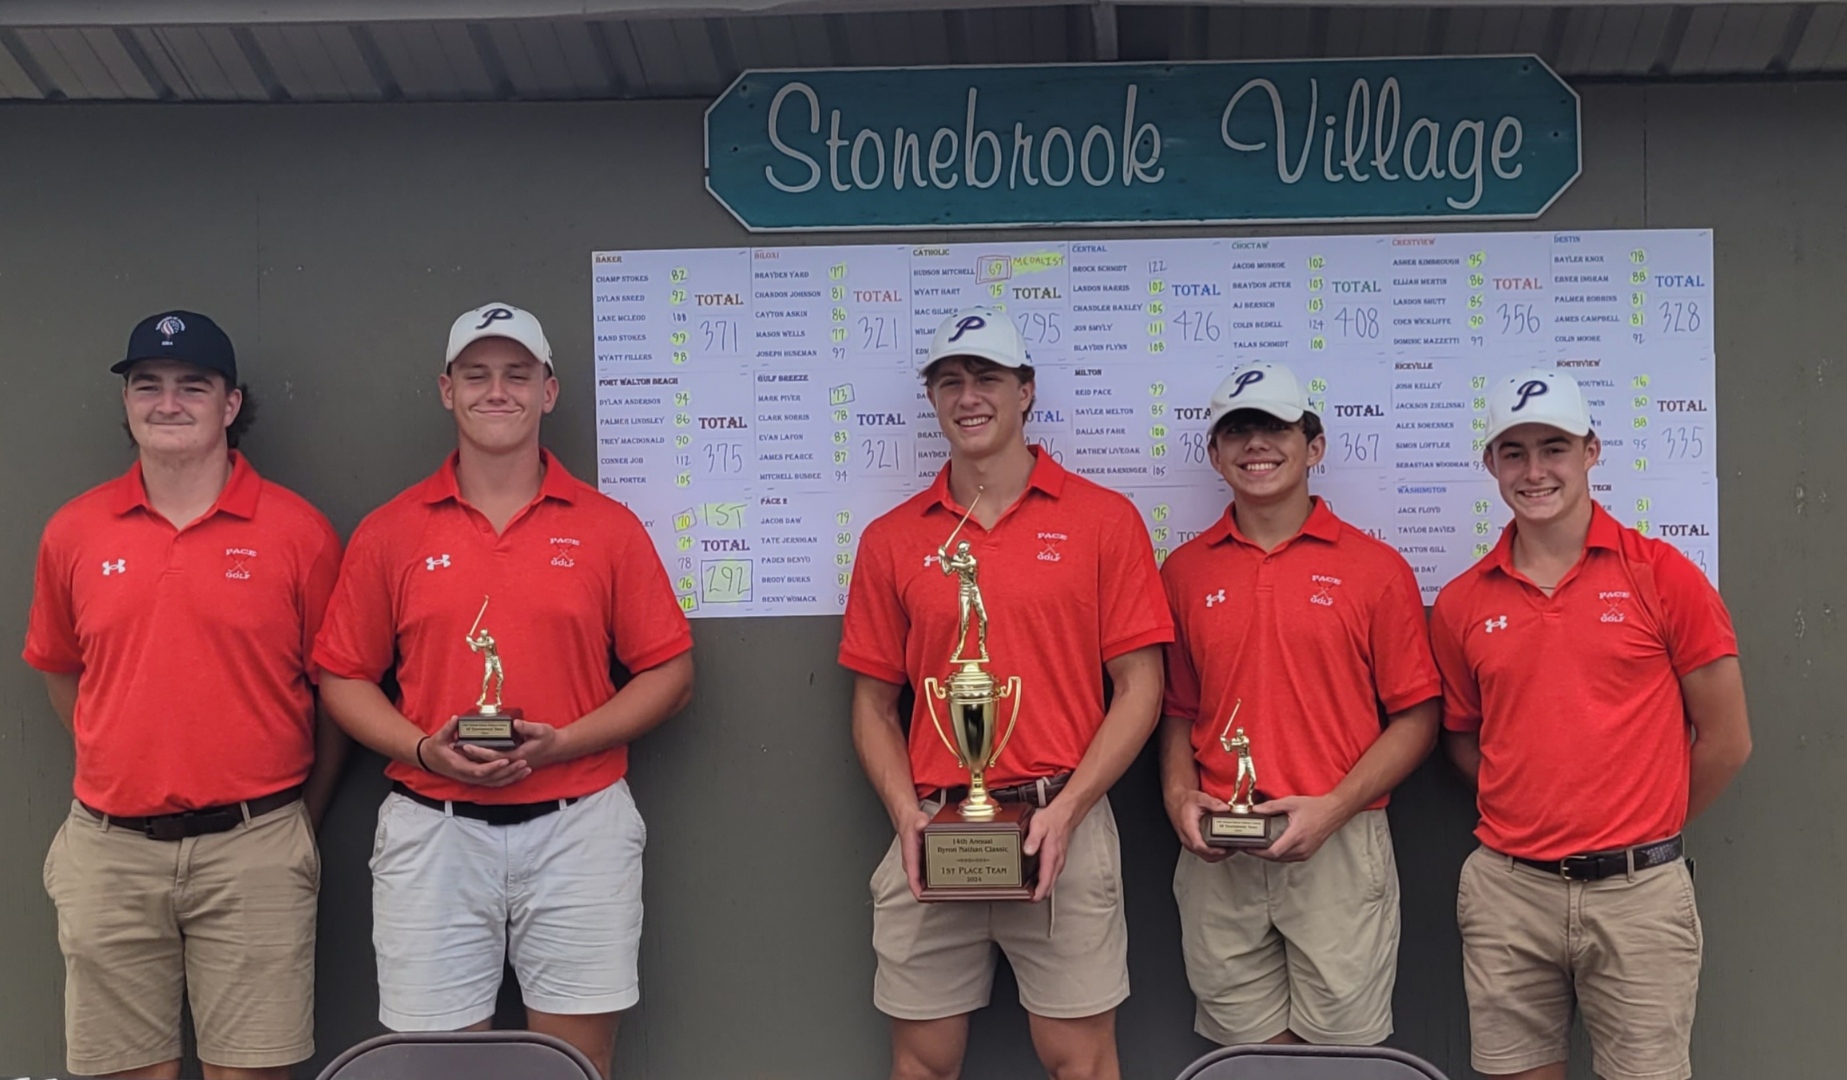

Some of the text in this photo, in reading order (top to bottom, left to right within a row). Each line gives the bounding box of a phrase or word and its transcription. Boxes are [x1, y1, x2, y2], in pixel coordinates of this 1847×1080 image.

[765, 76, 1523, 209] Stonebrook Village
[1554, 235, 1580, 243] DESTIN
[1072, 245, 1107, 253] CENTRAL
[1013, 255, 1065, 266] MEDALIST
[1469, 254, 1482, 265] 95
[1631, 251, 1644, 262] 78
[1149, 261, 1166, 272] 122
[1308, 258, 1324, 268] 102
[671, 270, 687, 280] 82
[789, 270, 809, 278] YARD
[830, 266, 844, 278] 77
[988, 264, 1002, 275] 69
[1470, 275, 1483, 285] 86
[1632, 271, 1646, 282] 88
[1655, 275, 1704, 287] TOTAL
[1149, 282, 1165, 292] 102
[1309, 279, 1323, 290] 103
[1332, 281, 1381, 293] TOTAL
[1493, 278, 1542, 290] TOTAL
[831, 288, 843, 299] 81
[914, 288, 937, 296] WYATT
[990, 285, 1002, 296] 75
[1013, 287, 1061, 299] TOTAL
[1172, 284, 1220, 296] TOTAL
[672, 291, 687, 302] 92
[695, 294, 743, 306] TOTAL
[854, 290, 902, 302] TOTAL
[1470, 296, 1481, 307] 85
[1632, 294, 1644, 305] 81
[1150, 303, 1163, 314] 105
[1308, 300, 1323, 310] 103
[475, 308, 513, 329] P
[832, 309, 846, 320] 86
[1497, 303, 1539, 334] 356
[1632, 314, 1643, 325] 81
[1659, 302, 1700, 333] 328
[1174, 310, 1220, 342] 426
[1309, 320, 1324, 330] 124
[1335, 307, 1379, 338] 408
[1470, 316, 1483, 326] 90
[858, 317, 898, 349] 321
[948, 315, 986, 342] P
[1018, 313, 1060, 343] 295
[1150, 323, 1162, 334] 111
[672, 333, 686, 344] 99
[700, 321, 738, 352] 371
[756, 330, 780, 338] MASON
[832, 329, 845, 340] 77
[1633, 334, 1645, 344] 92
[1310, 339, 1323, 348] 100
[1470, 336, 1483, 346] 97
[674, 352, 687, 362] 98
[832, 347, 846, 359] 97
[1229, 370, 1264, 398] P
[1312, 380, 1326, 391] 86
[1472, 377, 1485, 388] 87
[1633, 377, 1646, 387] 76
[833, 389, 847, 401] 73
[1151, 385, 1164, 396] 99
[1511, 380, 1548, 412] P
[675, 392, 689, 405] 94
[1473, 397, 1486, 408] 88
[1634, 397, 1647, 407] 80
[1152, 405, 1163, 415] 85
[1335, 405, 1383, 417] TOTAL
[1657, 400, 1707, 412] TOTAL
[676, 413, 690, 424] 86
[834, 410, 847, 421] 78
[857, 413, 905, 425] TOTAL
[699, 417, 747, 429] TOTAL
[1472, 419, 1485, 429] 86
[1634, 418, 1646, 428] 88
[834, 431, 847, 442] 83
[1151, 427, 1165, 436] 100
[676, 435, 689, 446] 90
[1472, 440, 1485, 450] 85
[1633, 439, 1647, 449] 95
[1662, 427, 1703, 459] 335
[1151, 446, 1165, 457] 103
[1340, 433, 1379, 461] 367
[676, 455, 690, 466] 112
[703, 443, 742, 473] 375
[834, 452, 846, 463] 87
[862, 440, 900, 470] 321
[1635, 459, 1646, 470] 91
[834, 470, 848, 482] 94
[1153, 465, 1165, 476] 105
[676, 474, 690, 485] 105
[1475, 501, 1488, 512] 84
[1637, 500, 1649, 511] 81
[704, 503, 747, 529] 1ST
[837, 512, 850, 524] 79
[1154, 508, 1167, 519] 75
[678, 516, 690, 527] 70
[1476, 522, 1488, 534] 85
[1660, 525, 1709, 536] TOTAL
[838, 533, 851, 544] 80
[1155, 529, 1167, 539] 75
[550, 537, 580, 545] PACE
[679, 538, 693, 548] 74
[702, 539, 749, 551] TOTAL
[226, 548, 257, 557] PACE
[1476, 543, 1487, 554] 98
[551, 559, 574, 567] GOLF
[678, 556, 692, 569] 78
[837, 554, 850, 564] 82
[1037, 553, 1061, 562] GOLF
[225, 571, 251, 580] GOLF
[706, 566, 750, 594] 292
[838, 575, 849, 585] 81
[1312, 574, 1341, 585] PACE
[679, 578, 692, 588] 76
[1310, 595, 1333, 606] GOLF
[1600, 615, 1624, 623] GOLF
